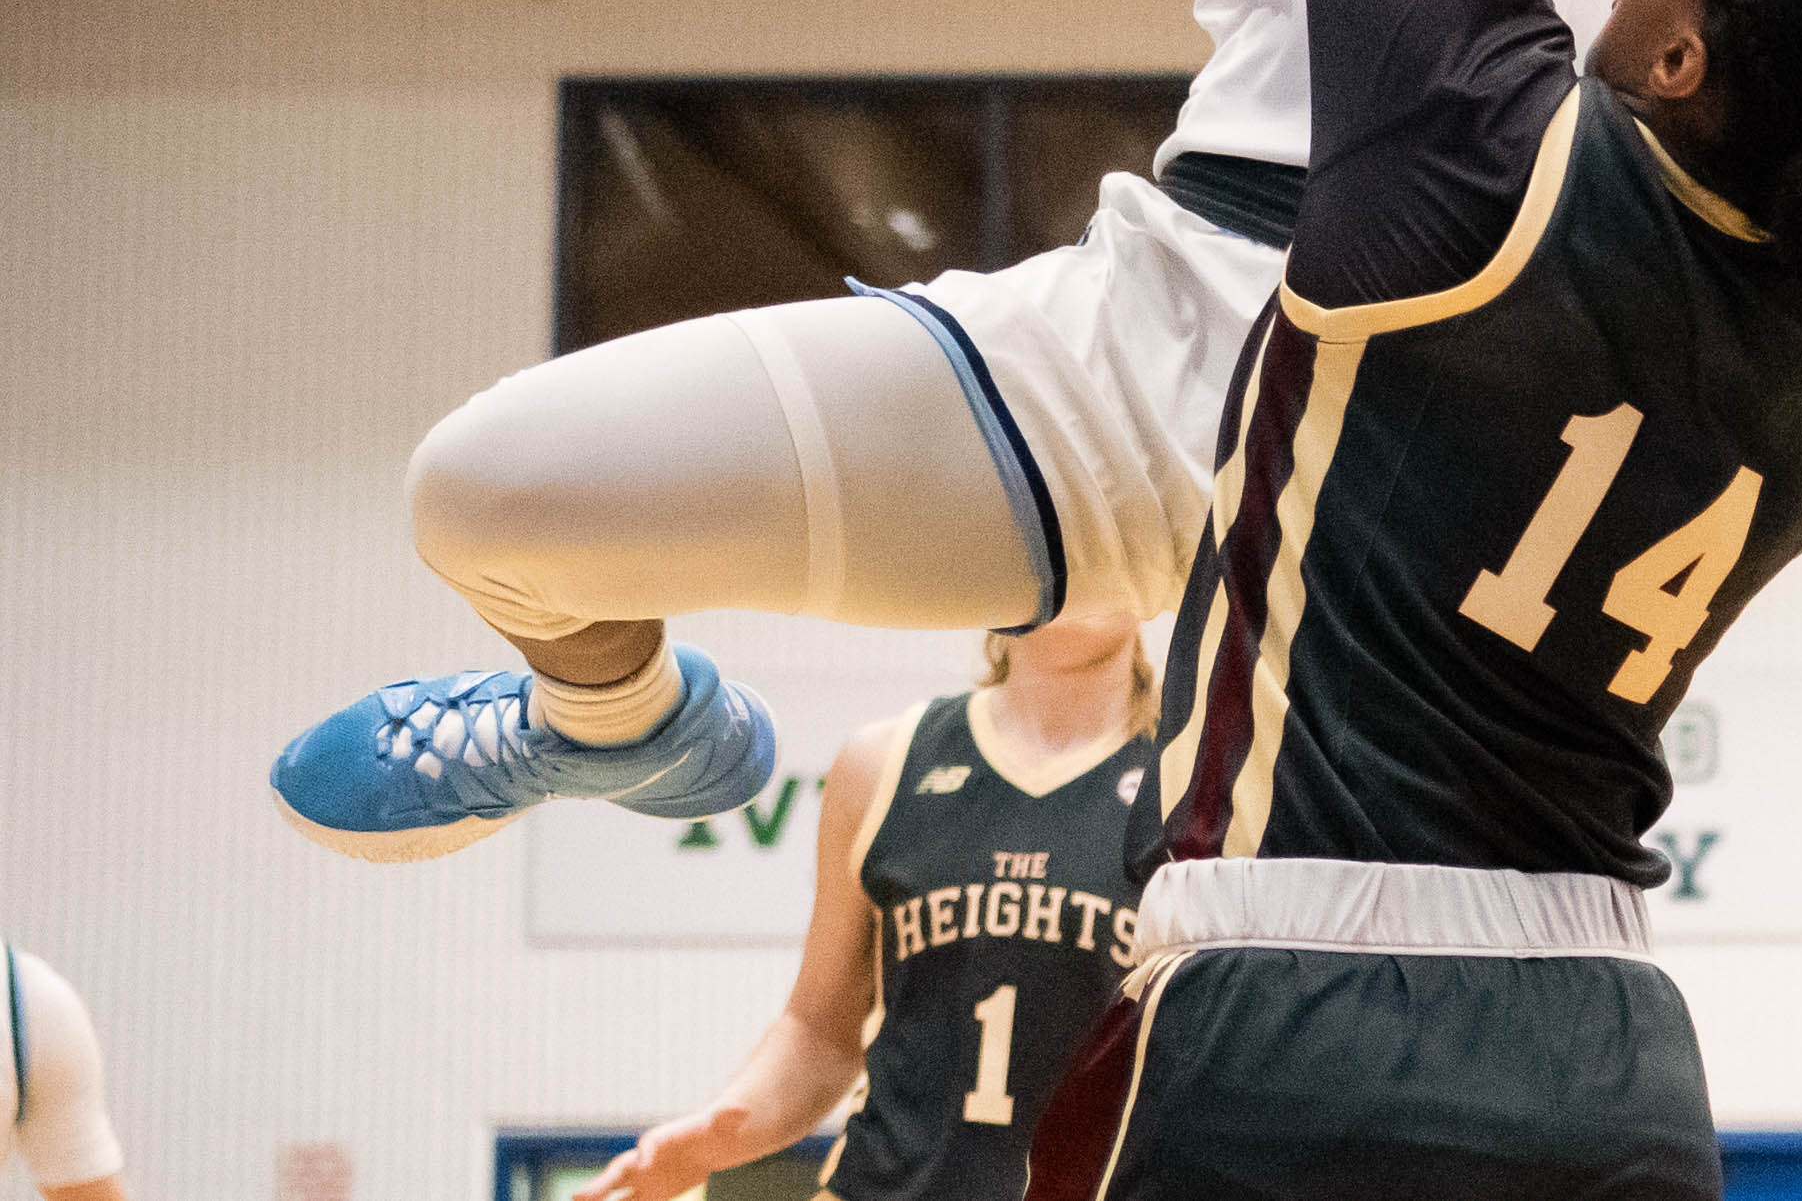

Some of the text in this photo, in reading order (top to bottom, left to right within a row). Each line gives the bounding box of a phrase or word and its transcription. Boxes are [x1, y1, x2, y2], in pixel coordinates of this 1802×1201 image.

[1458, 401, 1764, 705] 14
[992, 851, 1050, 879] THE
[893, 881, 1140, 969] HEIGHTS
[962, 984, 1018, 1126] 1
